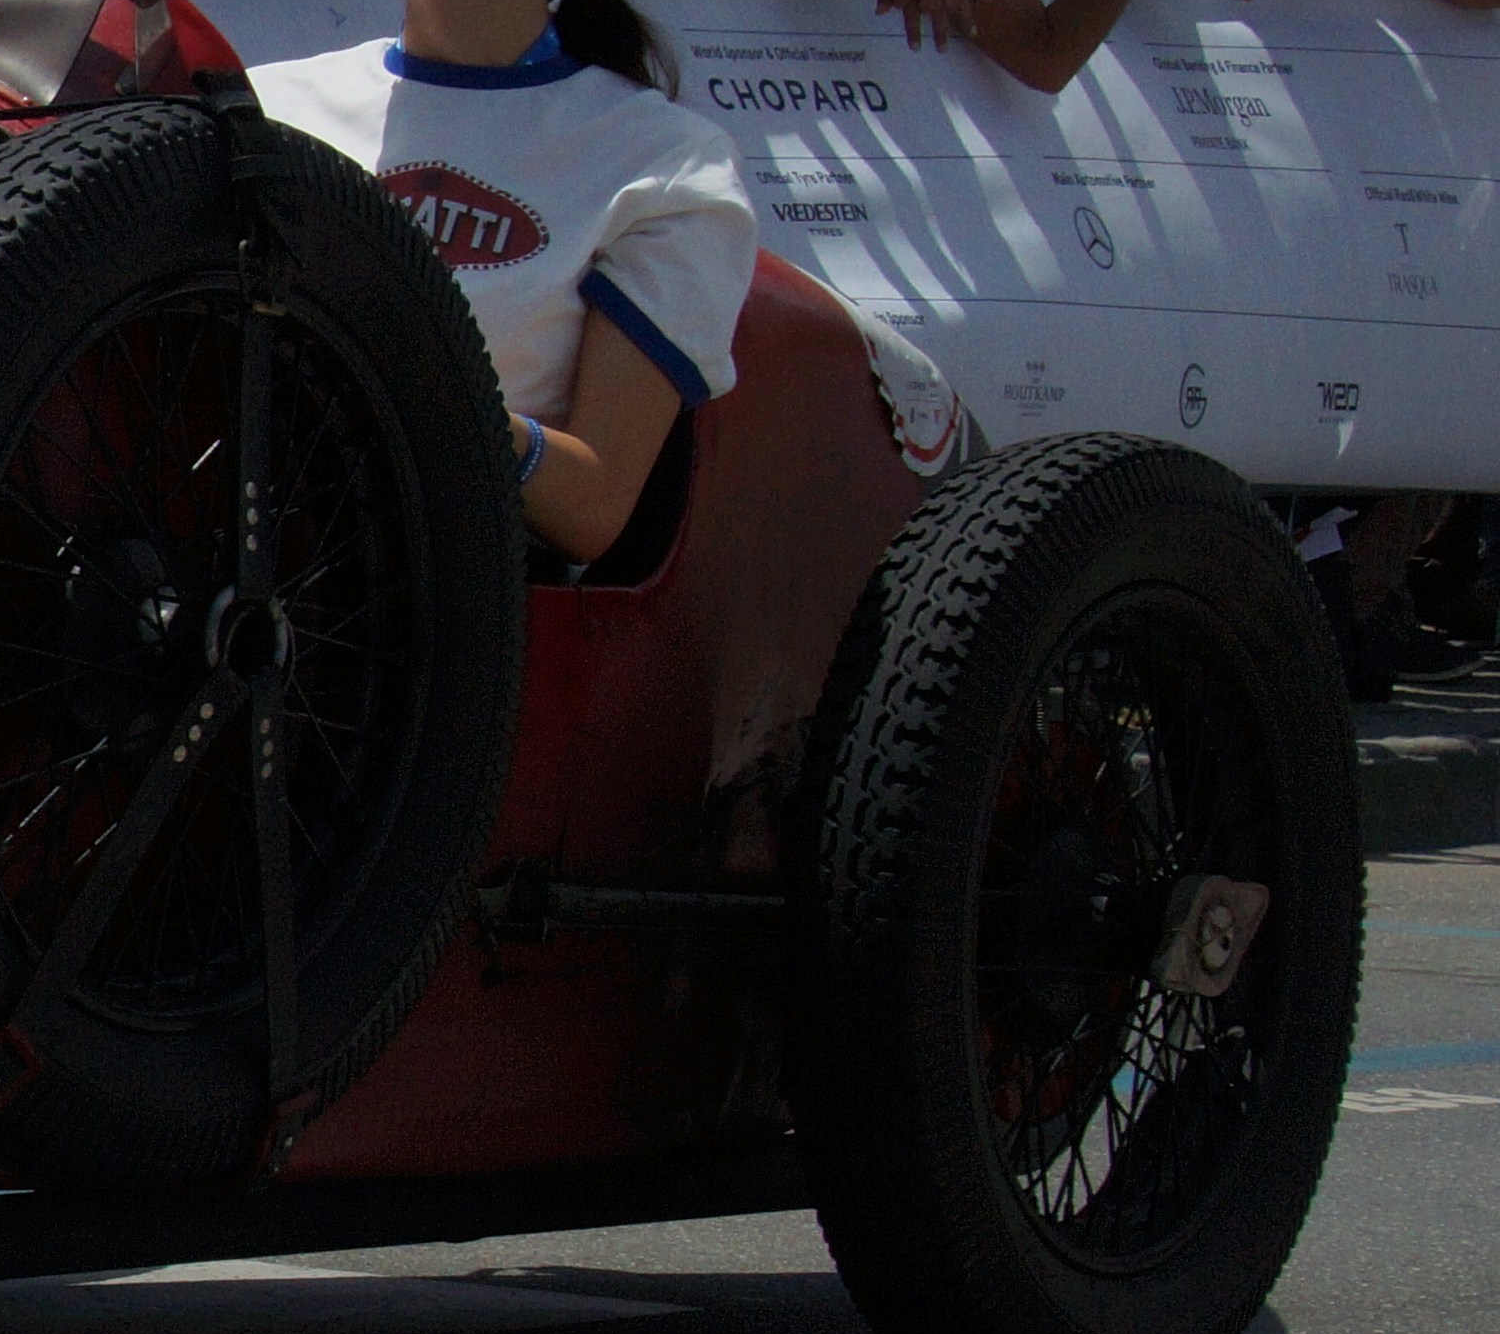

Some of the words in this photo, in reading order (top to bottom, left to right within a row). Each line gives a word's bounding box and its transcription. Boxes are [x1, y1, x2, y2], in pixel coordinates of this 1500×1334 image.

[691, 46, 723, 59] World
[723, 46, 763, 61] Sponsor
[774, 46, 809, 60] Official
[809, 47, 866, 63] Timekeeper
[1152, 56, 1182, 70] Global
[1181, 58, 1219, 75] Banking
[1225, 60, 1260, 74] Finance
[1260, 61, 1293, 74] Partner
[708, 78, 888, 113] CHOPARD
[756, 171, 792, 184] Official
[791, 171, 818, 187] Tyre
[815, 171, 856, 184] Partner
[1051, 172, 1076, 185] Main
[1123, 175, 1155, 188] Partner
[1364, 187, 1394, 200] Official
[772, 202, 868, 222] VREDESTEIN
[400, 194, 512, 255] ATTI
[808, 228, 843, 237] TYRES
[1004, 384, 1065, 402] HOUTKAMP
